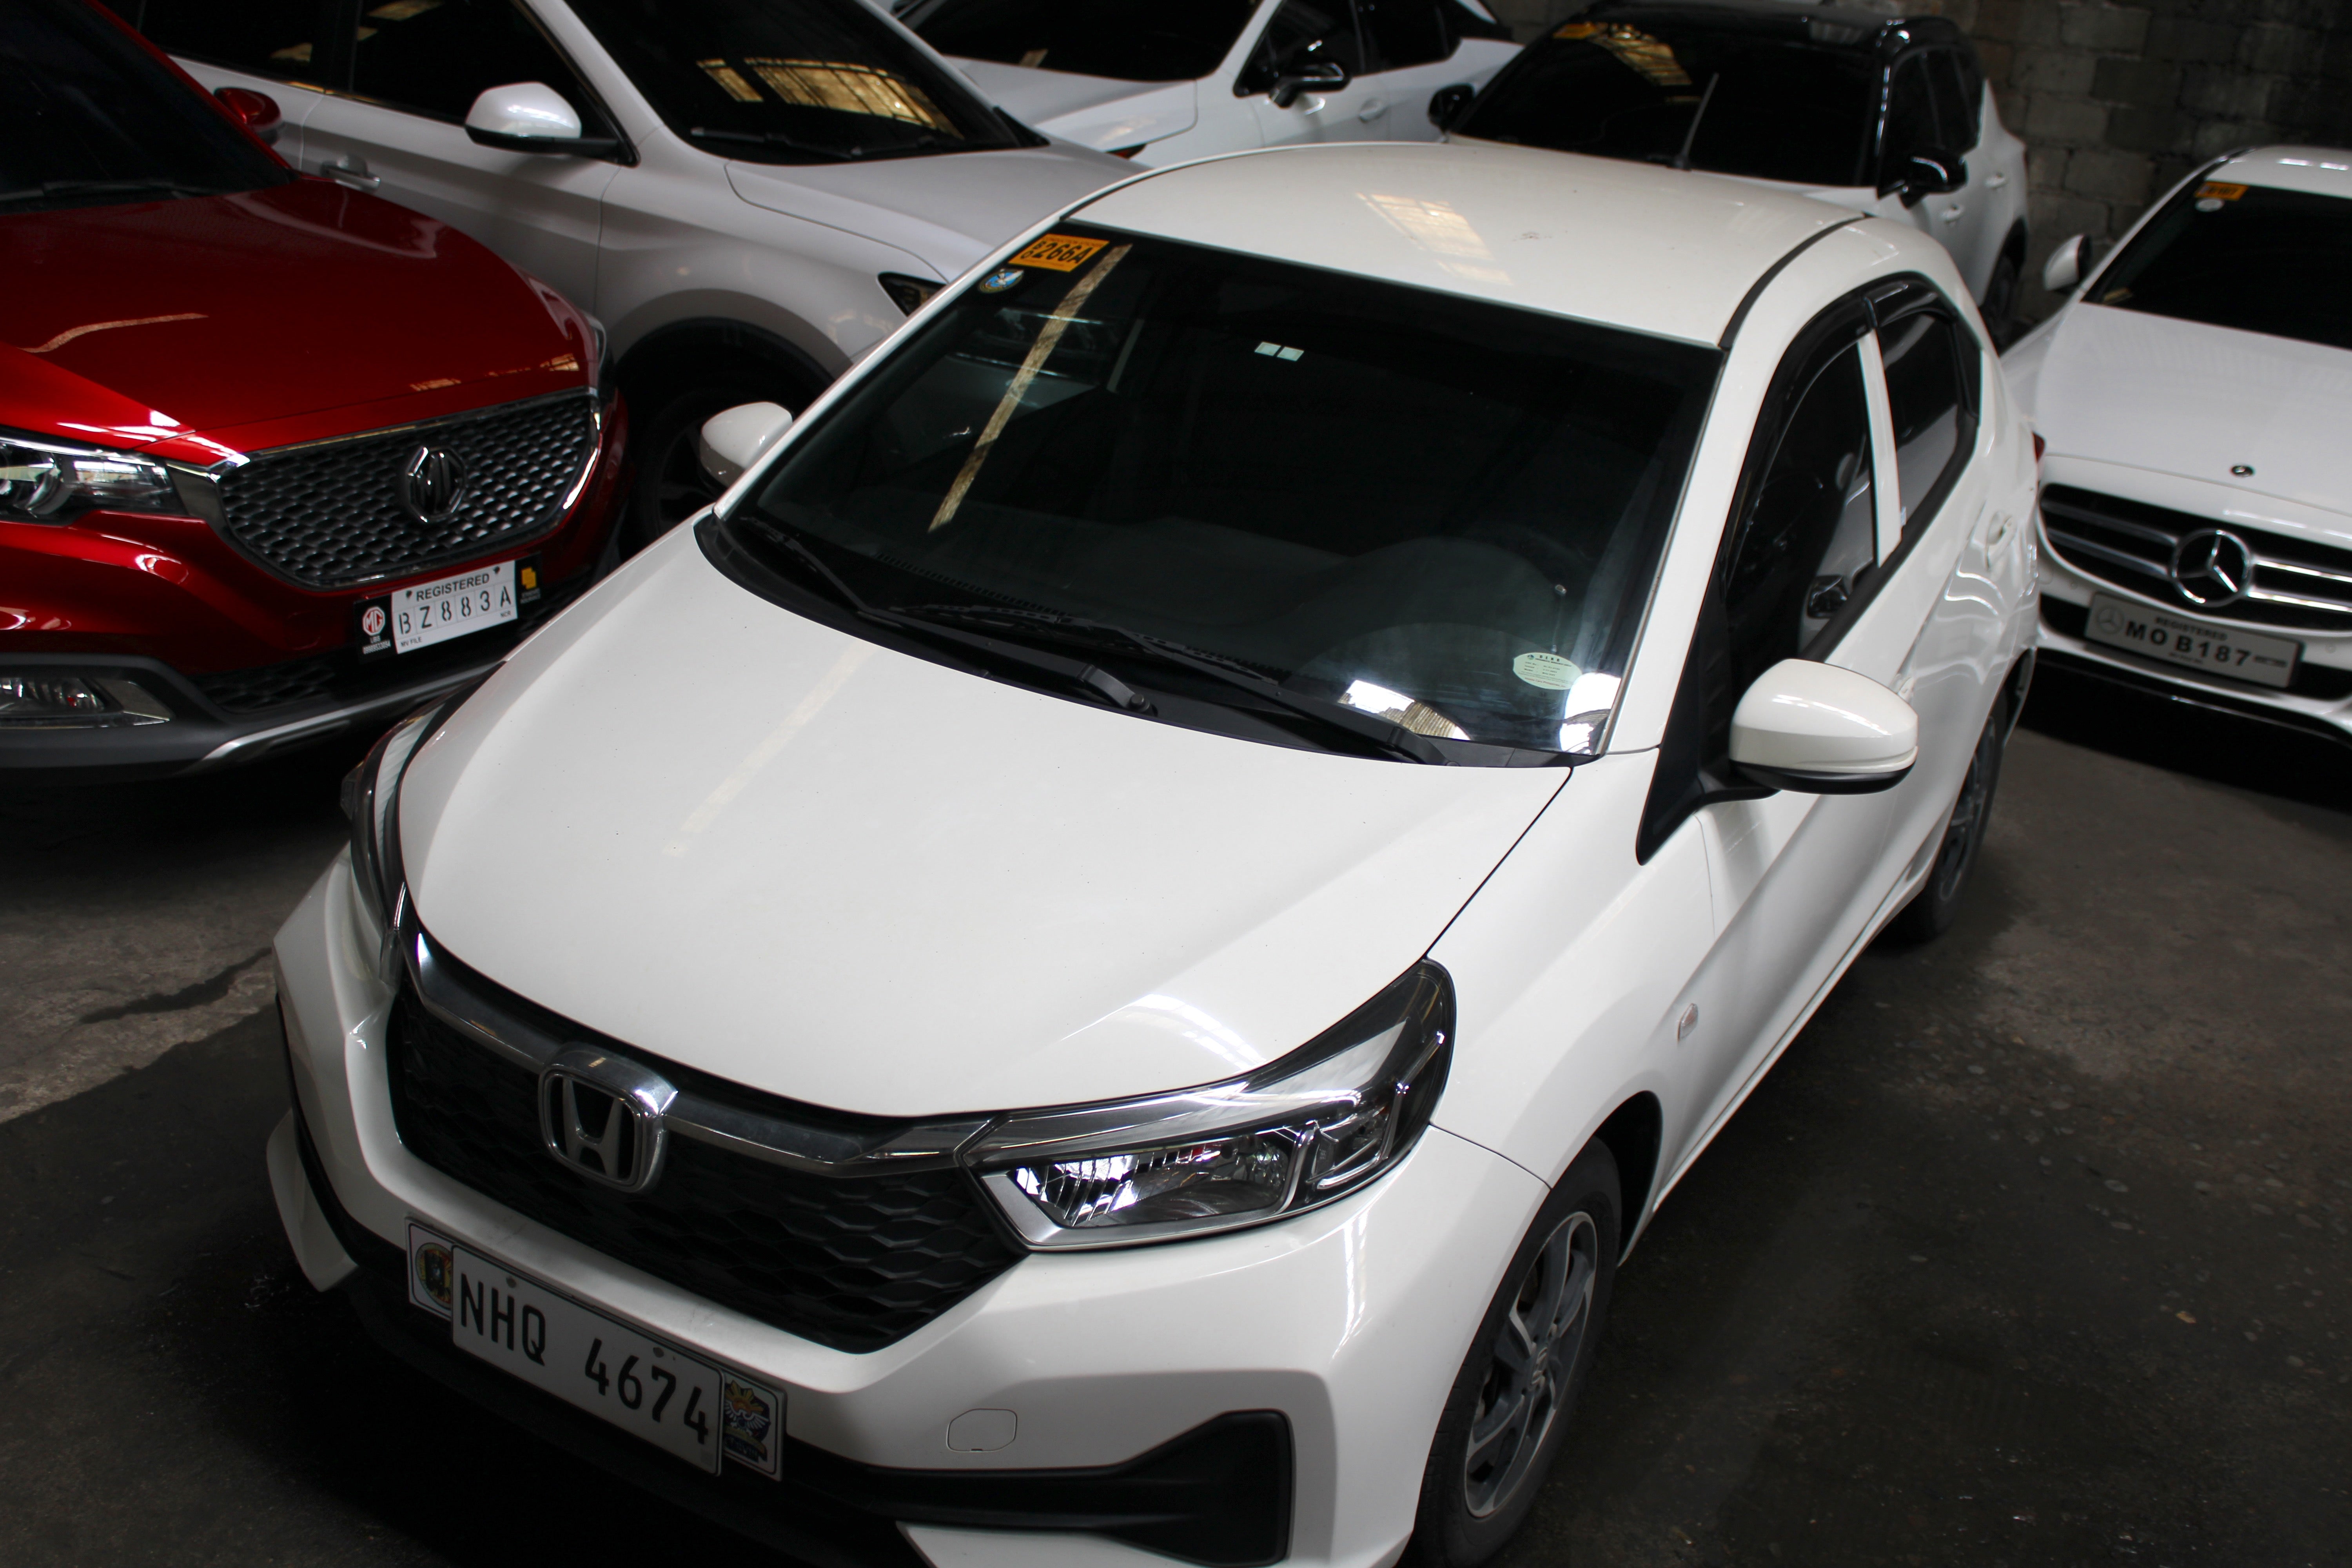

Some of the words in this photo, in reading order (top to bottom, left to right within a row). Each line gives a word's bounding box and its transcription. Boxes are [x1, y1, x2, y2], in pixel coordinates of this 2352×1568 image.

[1032, 242, 1093, 263] 266A
[416, 573, 490, 601] REGISTERED
[363, 607, 384, 634] MG
[411, 637, 422, 645] FILE
[460, 1272, 545, 1366] NHQ
[584, 1338, 709, 1445] 4674
